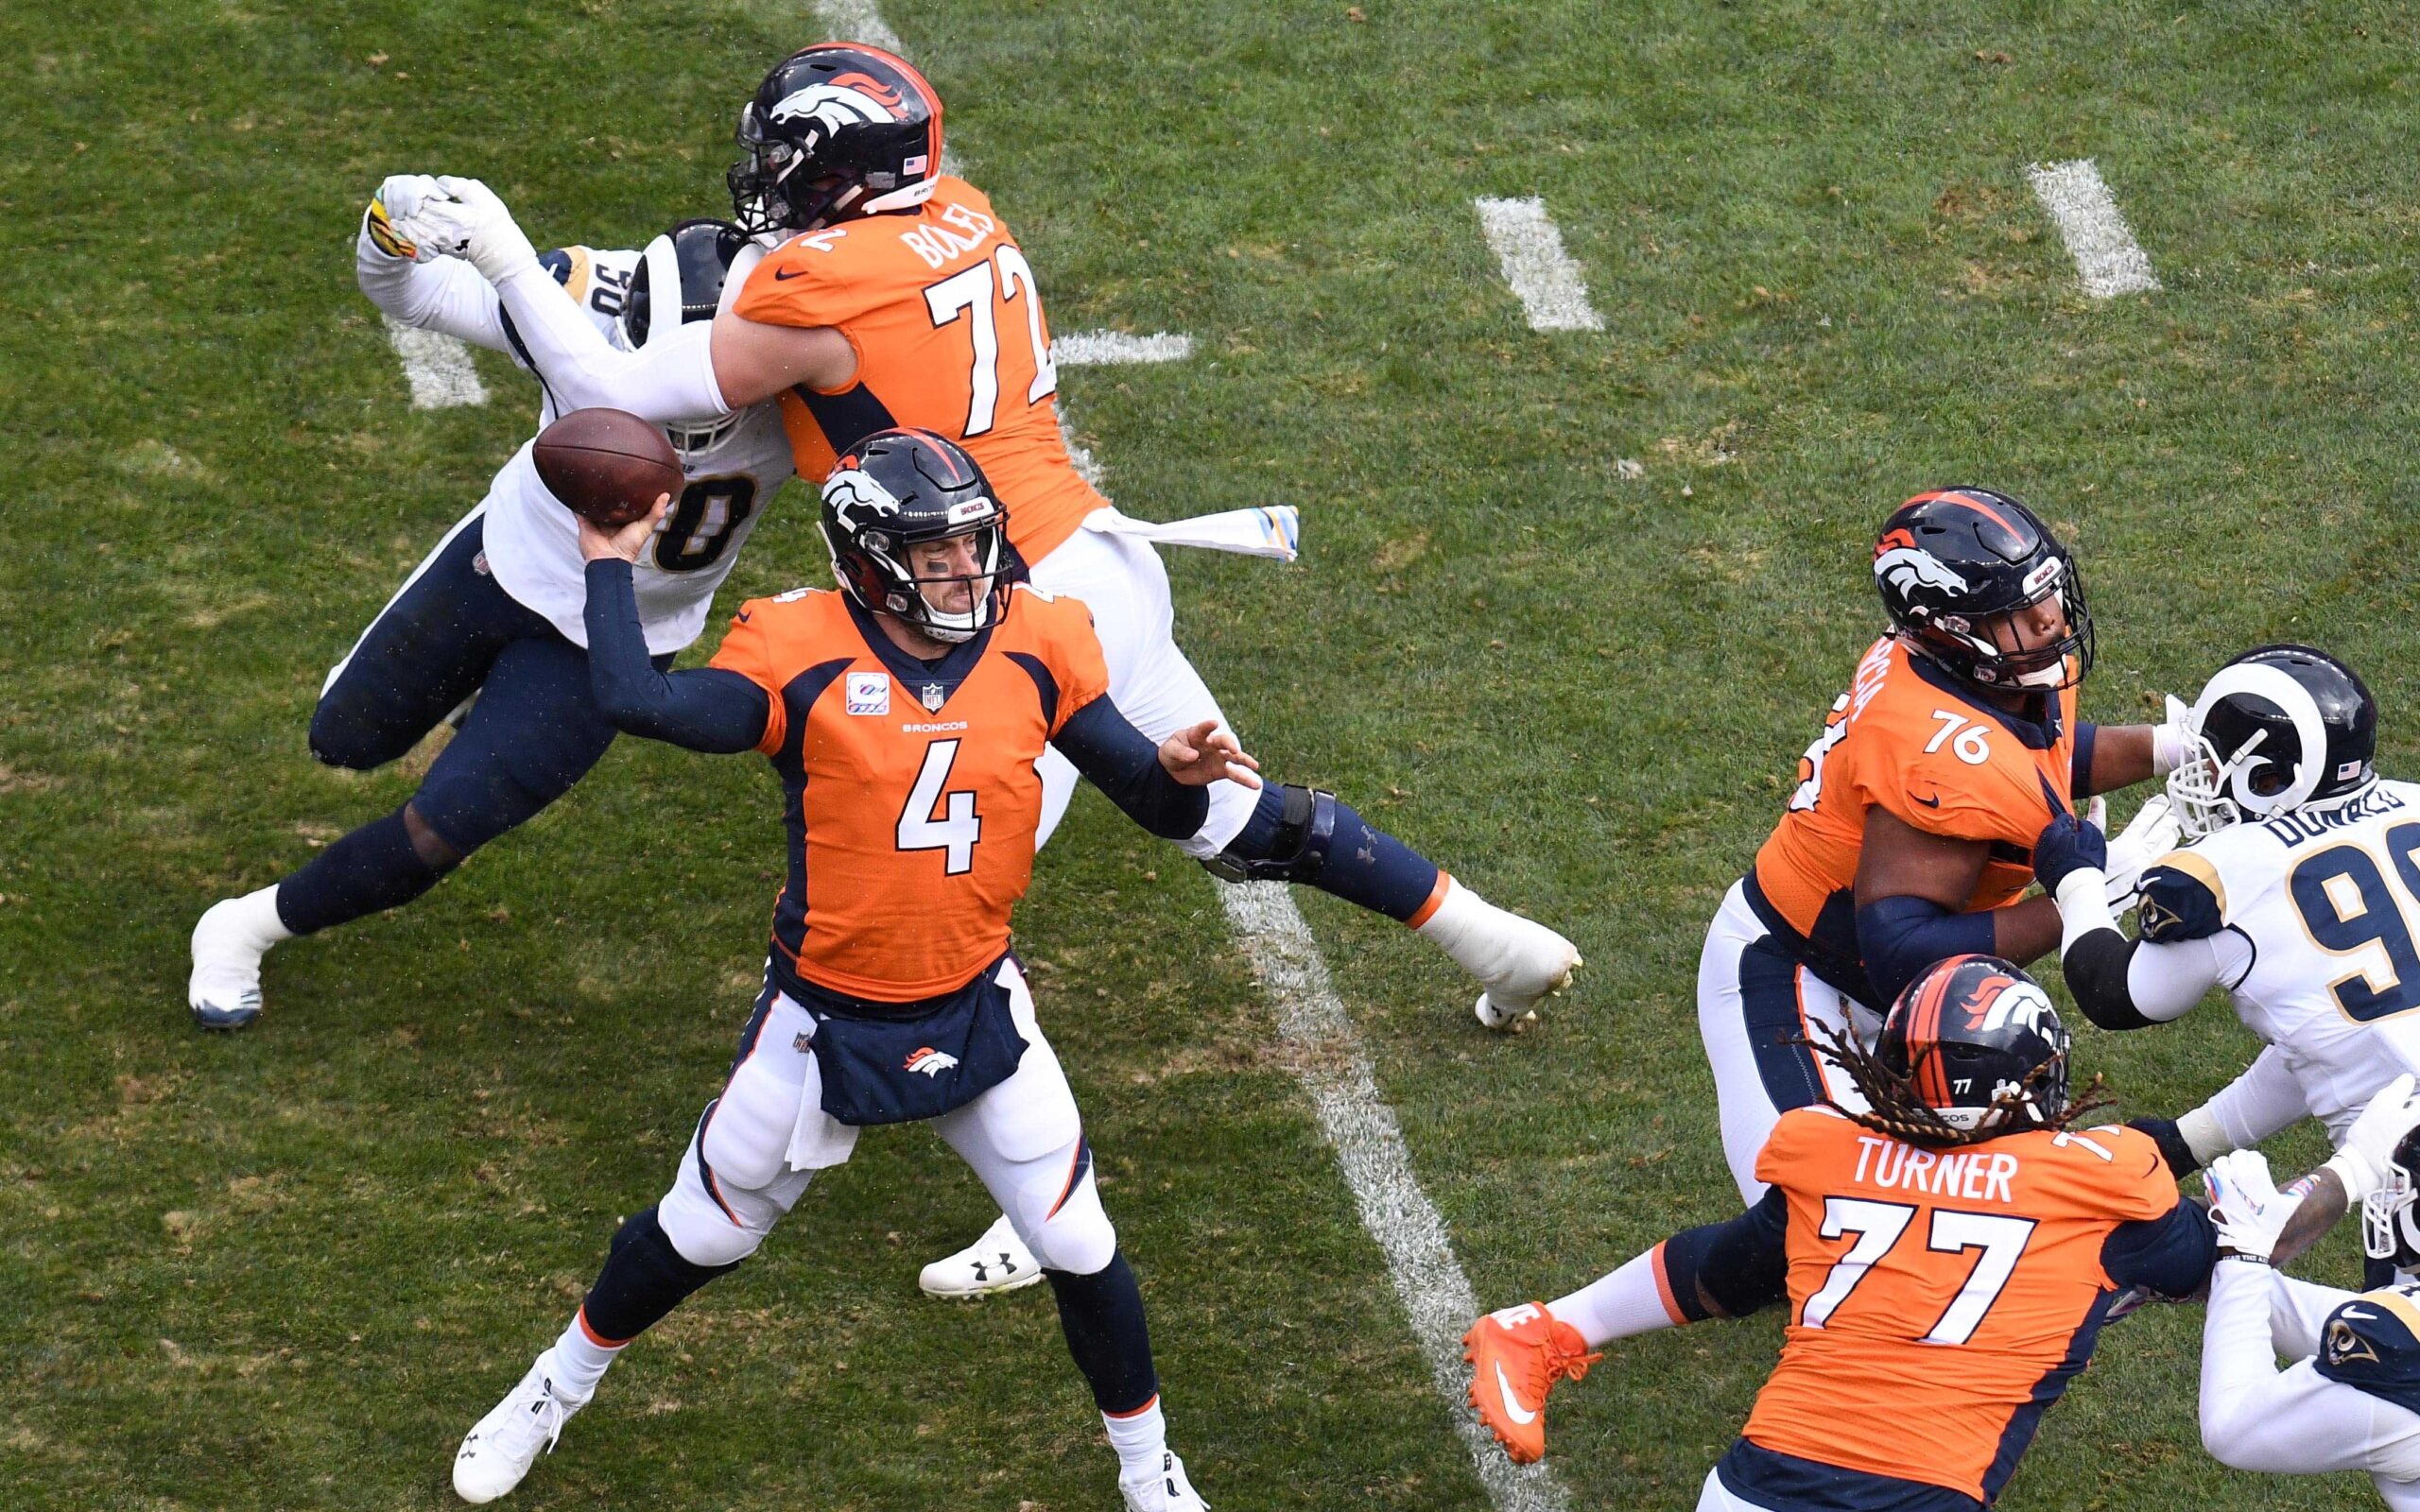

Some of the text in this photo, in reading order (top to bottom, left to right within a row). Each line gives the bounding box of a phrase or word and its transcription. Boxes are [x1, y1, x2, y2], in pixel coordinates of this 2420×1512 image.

[921, 243, 1058, 440] 72
[902, 721, 969, 733] BRONCOS
[1923, 709, 1994, 766] 76
[895, 737, 983, 878] 4
[1953, 1078, 1972, 1095] 77
[1854, 1136, 2018, 1203] TURNER
[1800, 1194, 2041, 1346] 77
